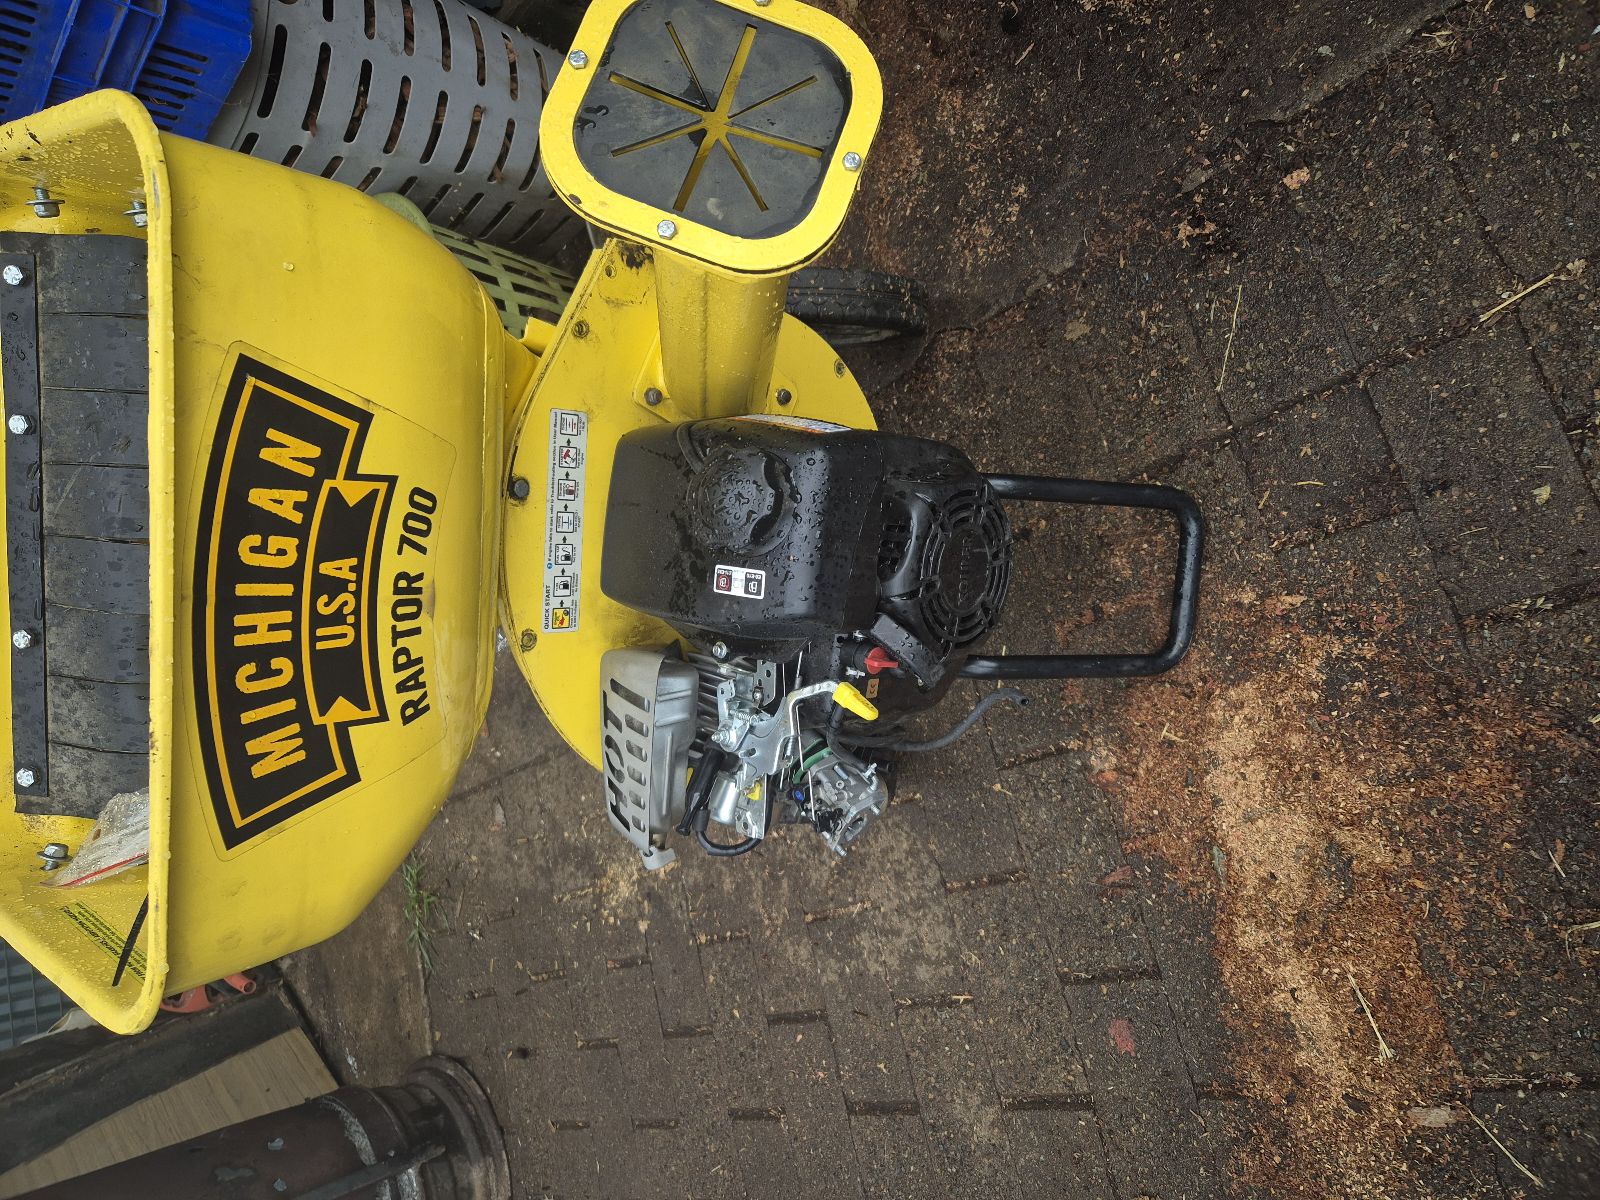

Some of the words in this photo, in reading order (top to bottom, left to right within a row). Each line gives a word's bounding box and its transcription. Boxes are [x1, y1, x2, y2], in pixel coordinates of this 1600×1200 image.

[397, 485, 438, 557] 700
[233, 427, 322, 780] MICHIGAN
[315, 557, 358, 650] U.S.A
[390, 570, 431, 727] RAPTOR
